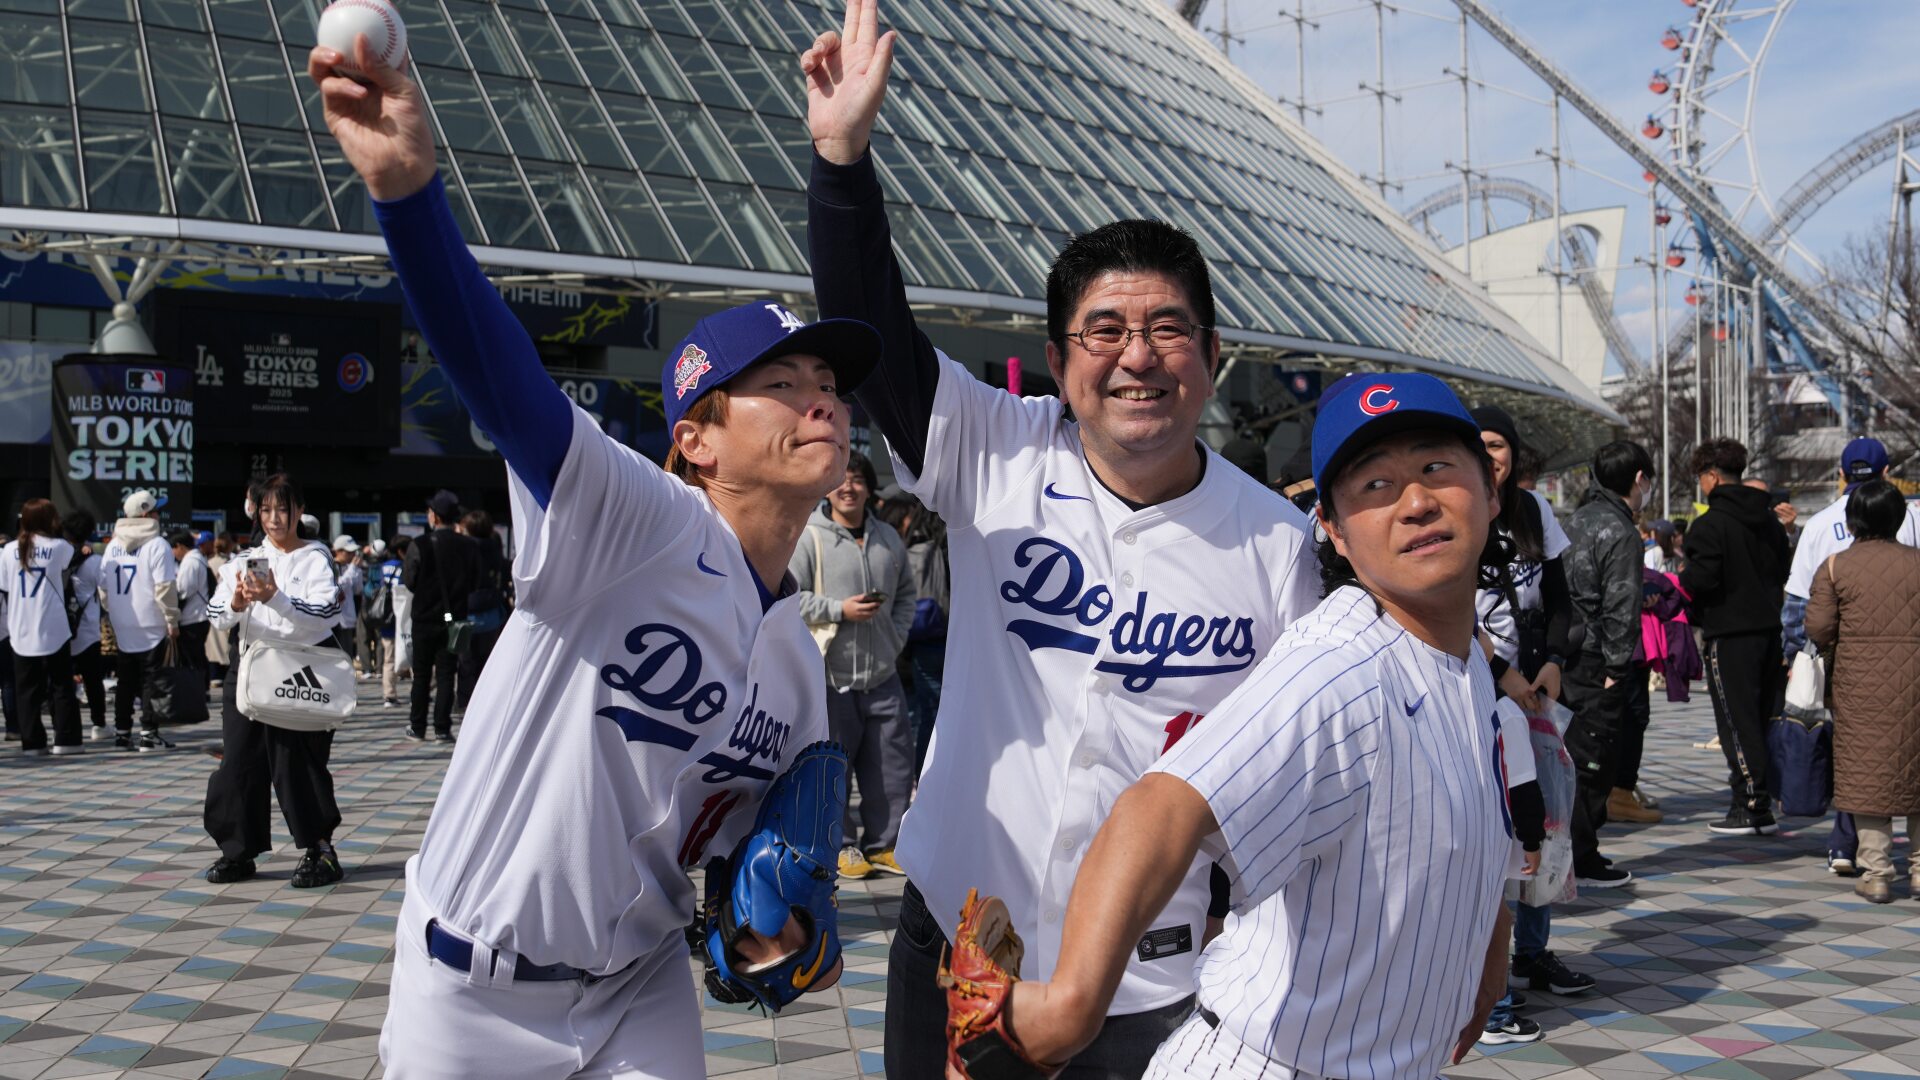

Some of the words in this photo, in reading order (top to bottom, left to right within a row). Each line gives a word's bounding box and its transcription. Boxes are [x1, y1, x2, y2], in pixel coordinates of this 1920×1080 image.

[263, 345, 295, 355] WORLD
[195, 344, 223, 387] LA
[245, 354, 317, 373] TOKYO
[243, 370, 320, 389] SERIES
[269, 388, 293, 398] 2025
[1358, 384, 1400, 416] C
[68, 395, 103, 412] MLB
[107, 396, 172, 414] WORLD
[71, 415, 193, 450] TOKYO
[251, 454, 268, 470] 22
[14, 545, 53, 561] OANI
[18, 566, 47, 598] 17
[115, 564, 138, 595] 17
[1000, 537, 1257, 693] Dodgers
[275, 686, 331, 704] adidas
